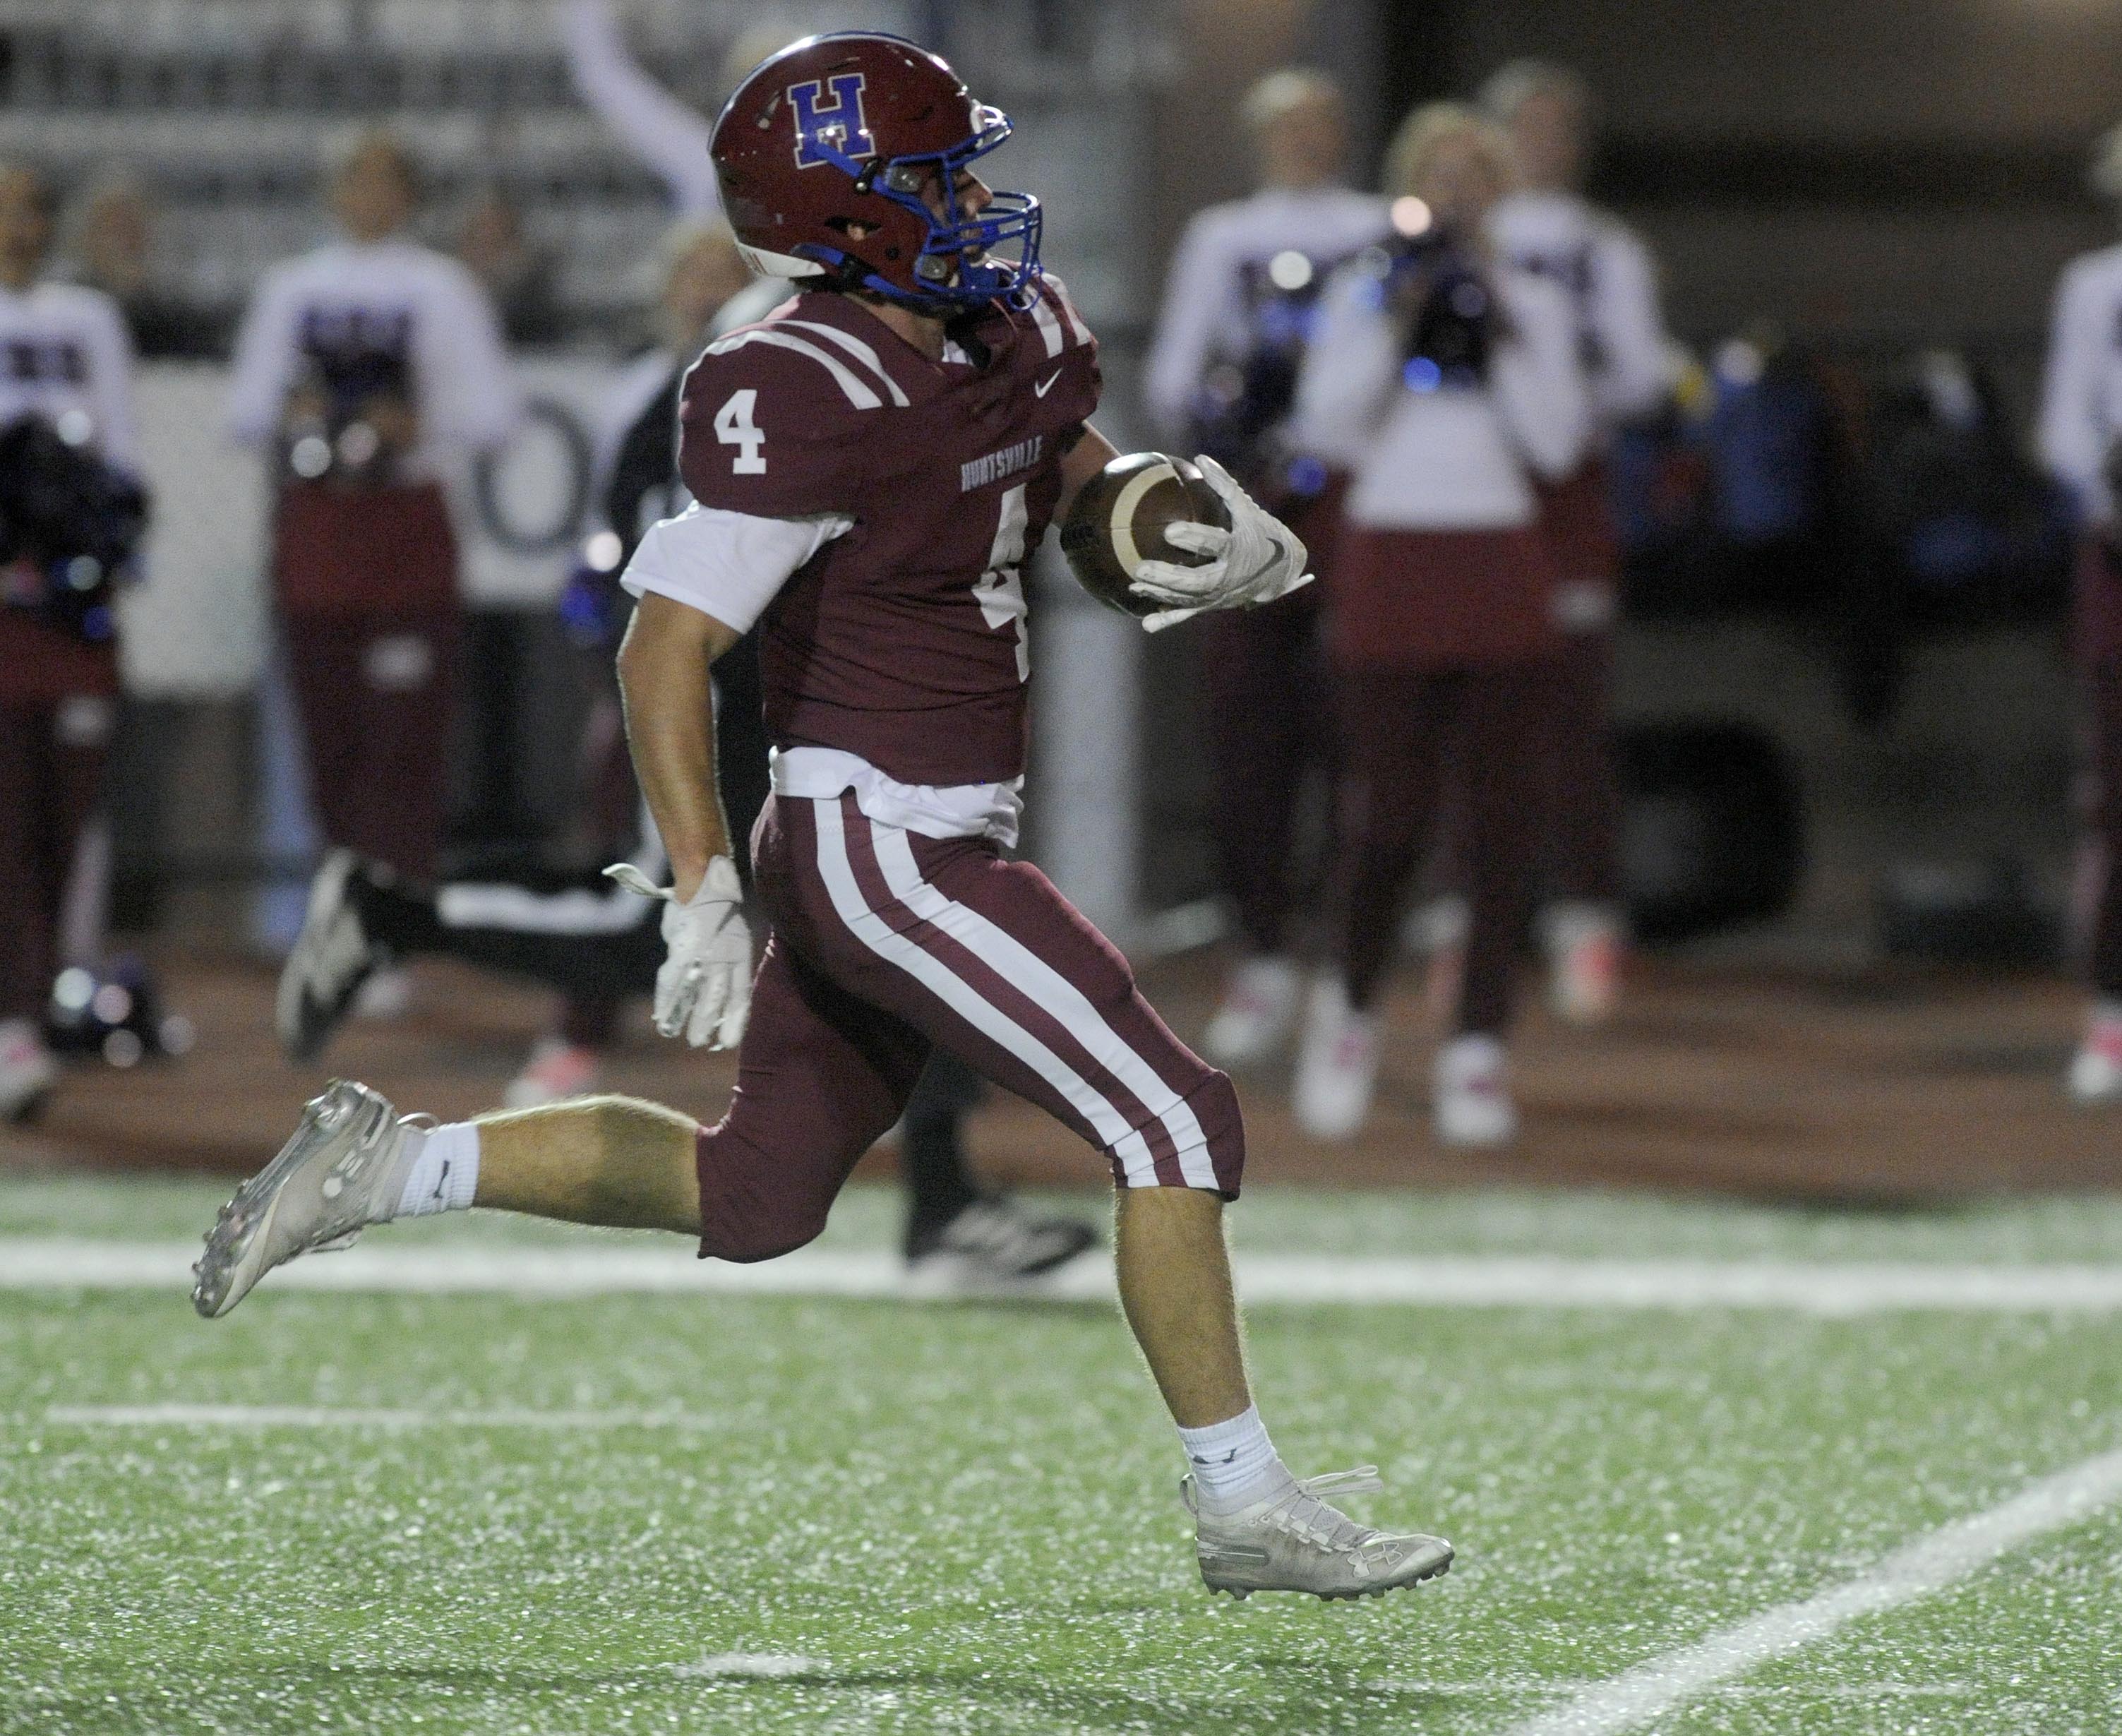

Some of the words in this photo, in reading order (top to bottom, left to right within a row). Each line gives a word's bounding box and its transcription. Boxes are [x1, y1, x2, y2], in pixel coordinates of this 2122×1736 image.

[787, 73, 876, 169] H
[714, 389, 766, 474] 4
[961, 436, 1043, 493] HUNTSVILLE
[971, 482, 1029, 683] 4
